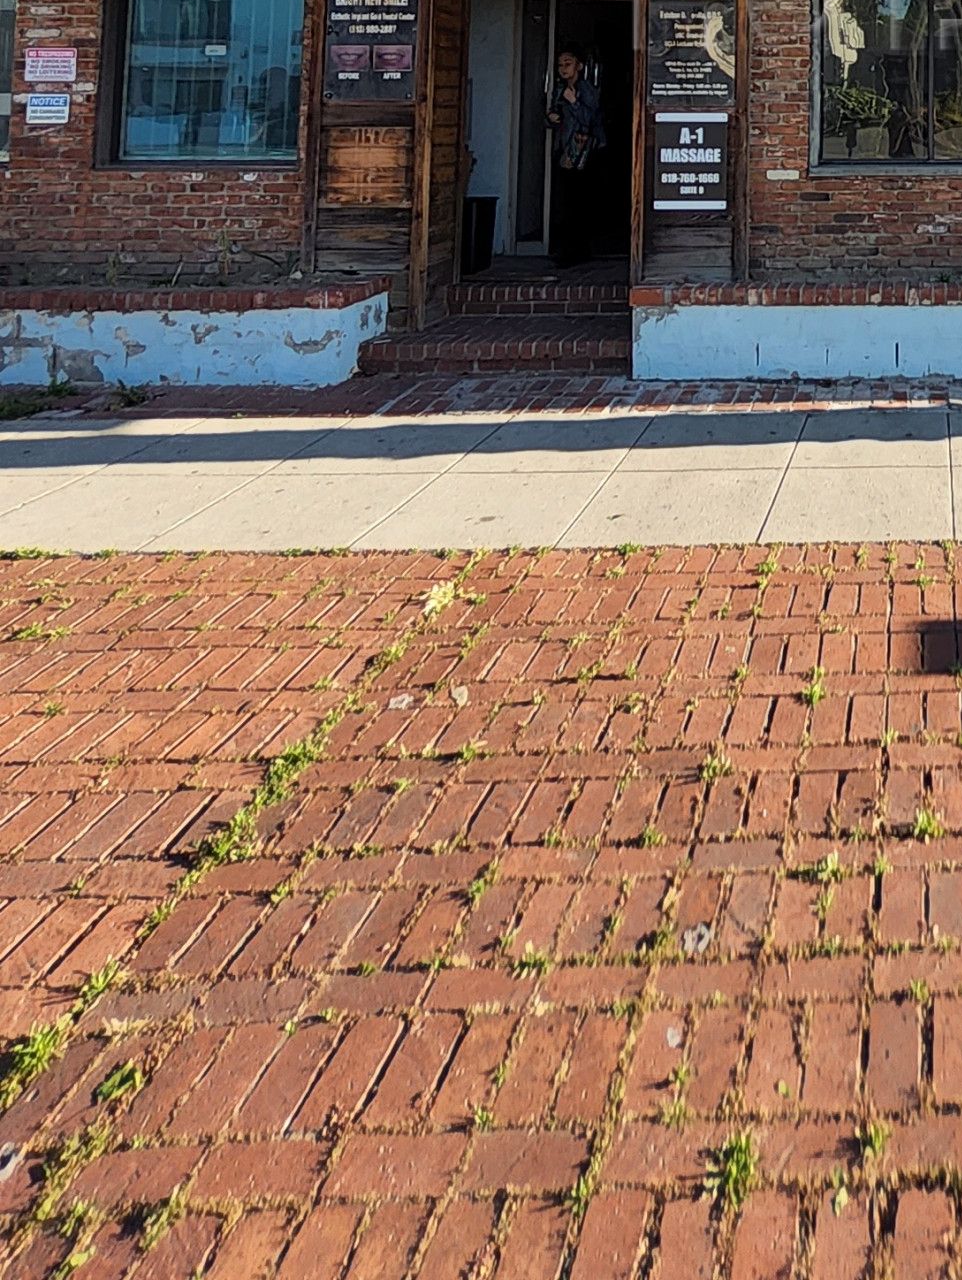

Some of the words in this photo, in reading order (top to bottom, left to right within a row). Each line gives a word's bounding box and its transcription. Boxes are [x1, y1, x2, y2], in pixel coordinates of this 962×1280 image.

[383, 72, 402, 80] AFTER
[30, 97, 66, 106] NOTICE
[679, 127, 704, 144] A-1
[660, 148, 721, 163] MASSAGE
